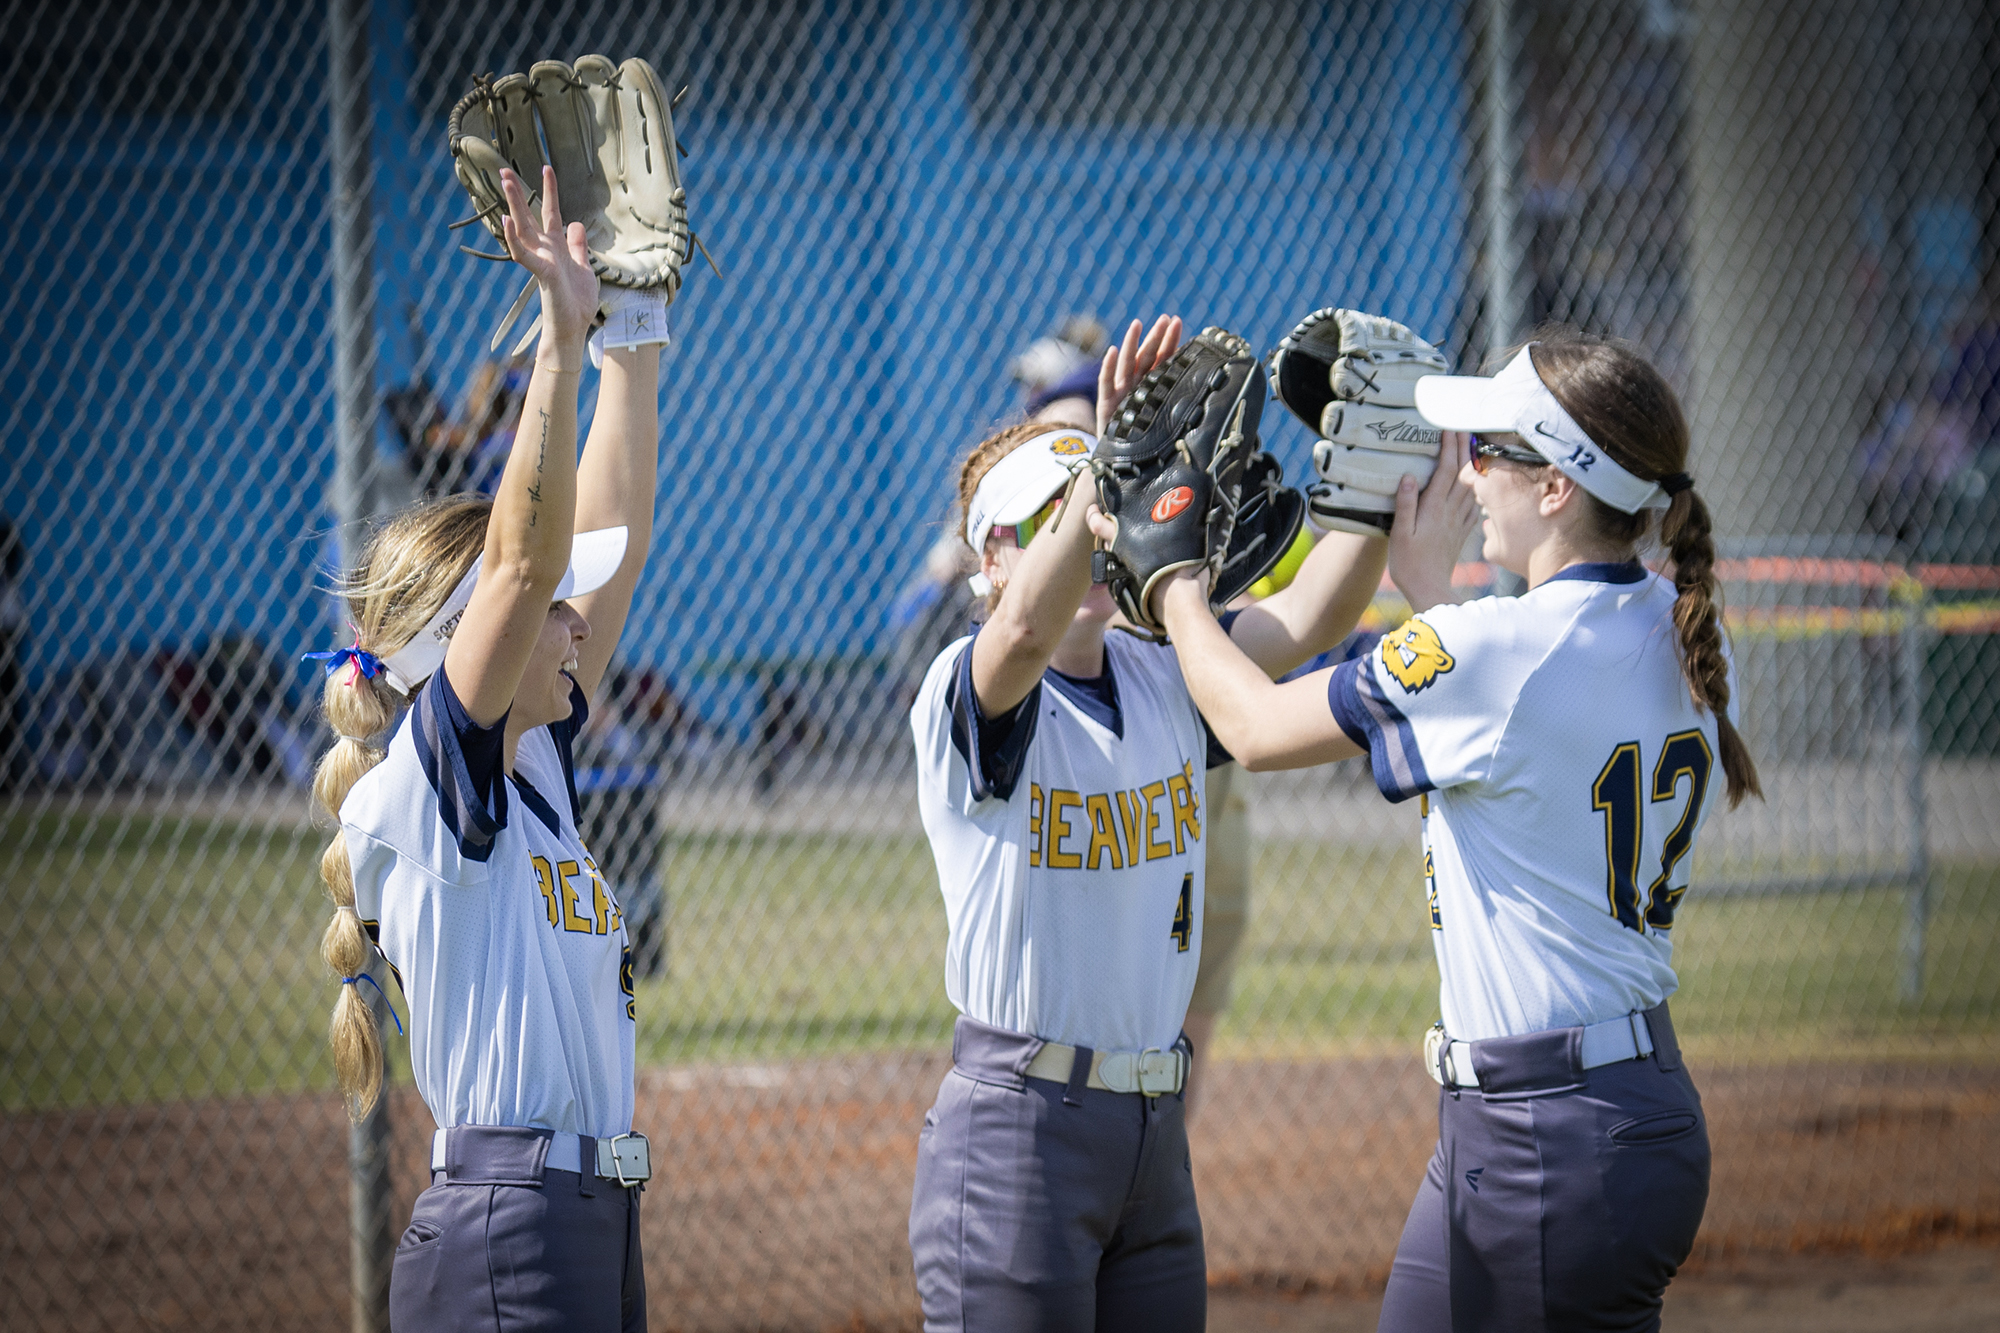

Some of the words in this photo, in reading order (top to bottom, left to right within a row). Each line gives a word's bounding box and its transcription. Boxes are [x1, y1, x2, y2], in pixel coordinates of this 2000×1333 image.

[1394, 424, 1442, 443] MIZU
[1568, 444, 1596, 473] 12
[1591, 727, 1713, 935] 12
[1170, 871, 1194, 953] 4
